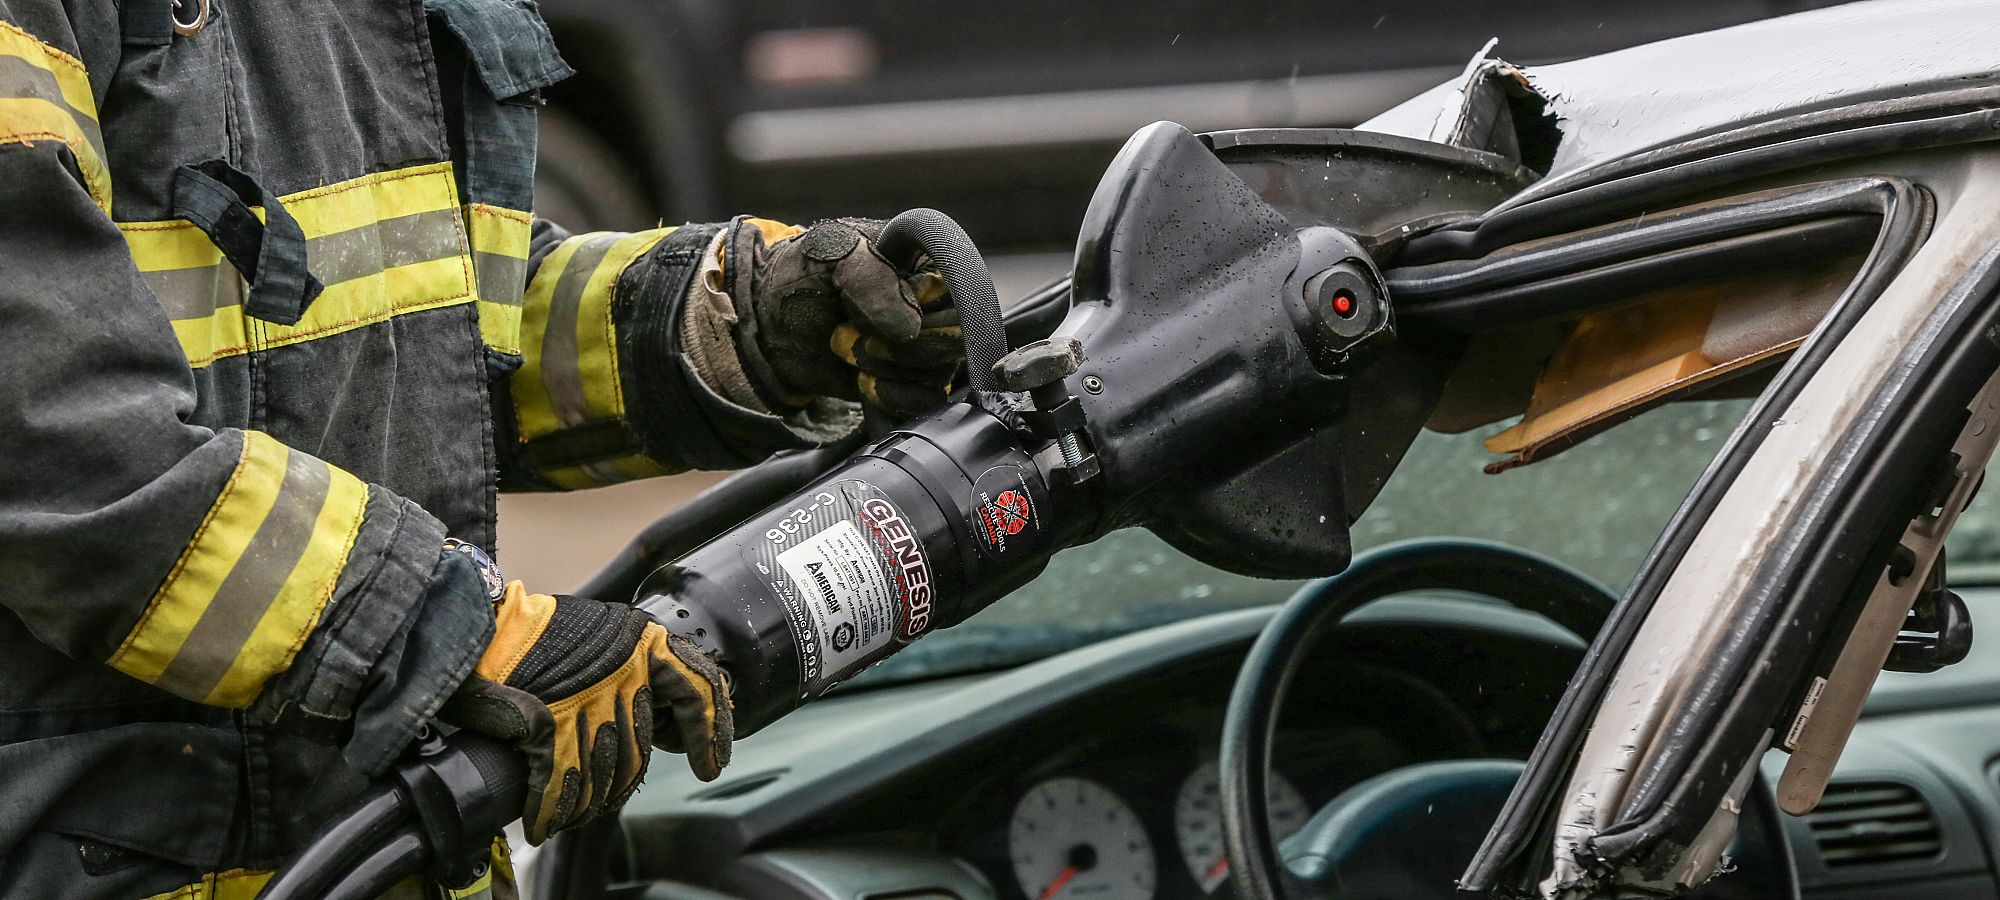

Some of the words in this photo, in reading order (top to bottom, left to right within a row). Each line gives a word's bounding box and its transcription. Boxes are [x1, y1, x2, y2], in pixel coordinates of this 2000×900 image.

[765, 492, 836, 544] C-236
[980, 491, 998, 524] RESCUE
[996, 525, 1005, 552] TOOLS
[980, 507, 997, 544] CANADA
[806, 562, 841, 614] AMERICAN
[862, 498, 931, 636] GENESIS
[783, 587, 807, 628] WARNING
